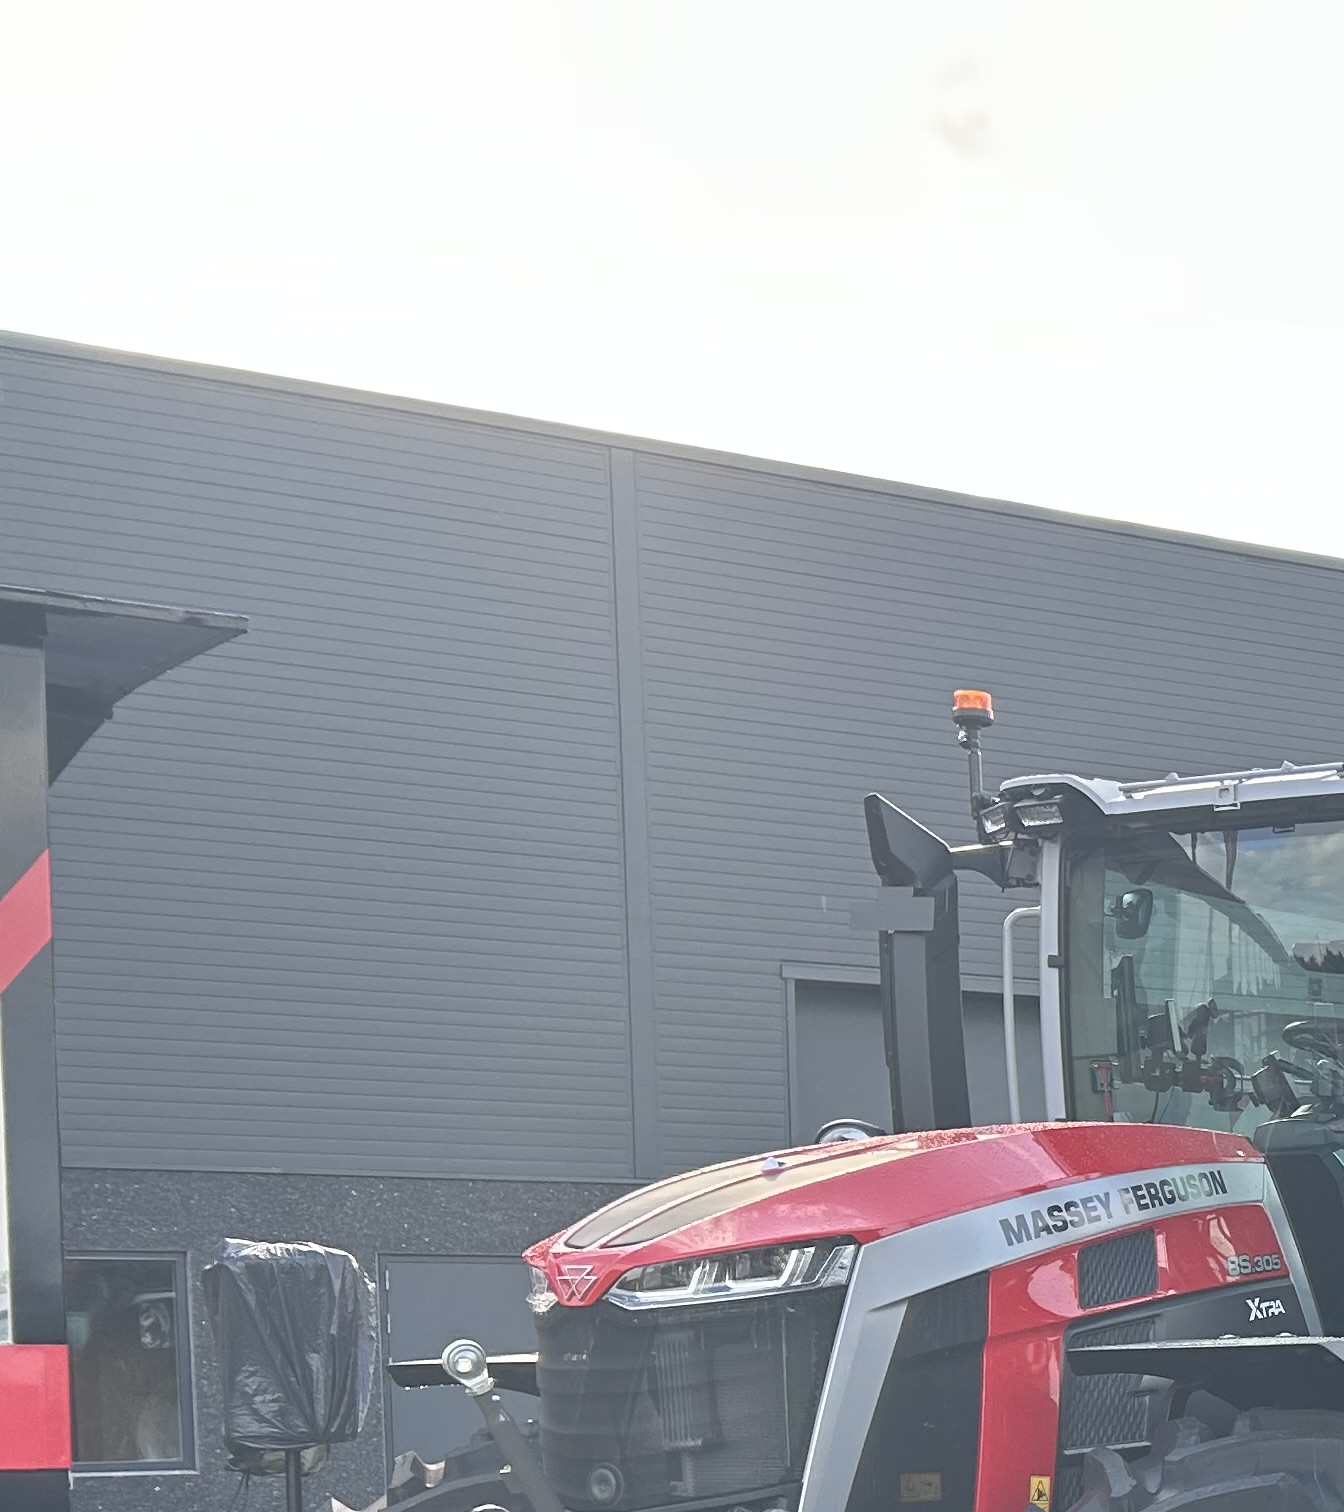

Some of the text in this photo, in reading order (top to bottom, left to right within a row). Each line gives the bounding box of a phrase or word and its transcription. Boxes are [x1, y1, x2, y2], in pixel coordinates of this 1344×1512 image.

[999, 1170, 1228, 1246] MASSEY FERGUSON
[1227, 1254, 1281, 1276] 8S.305
[1246, 1297, 1286, 1321] XTRA
